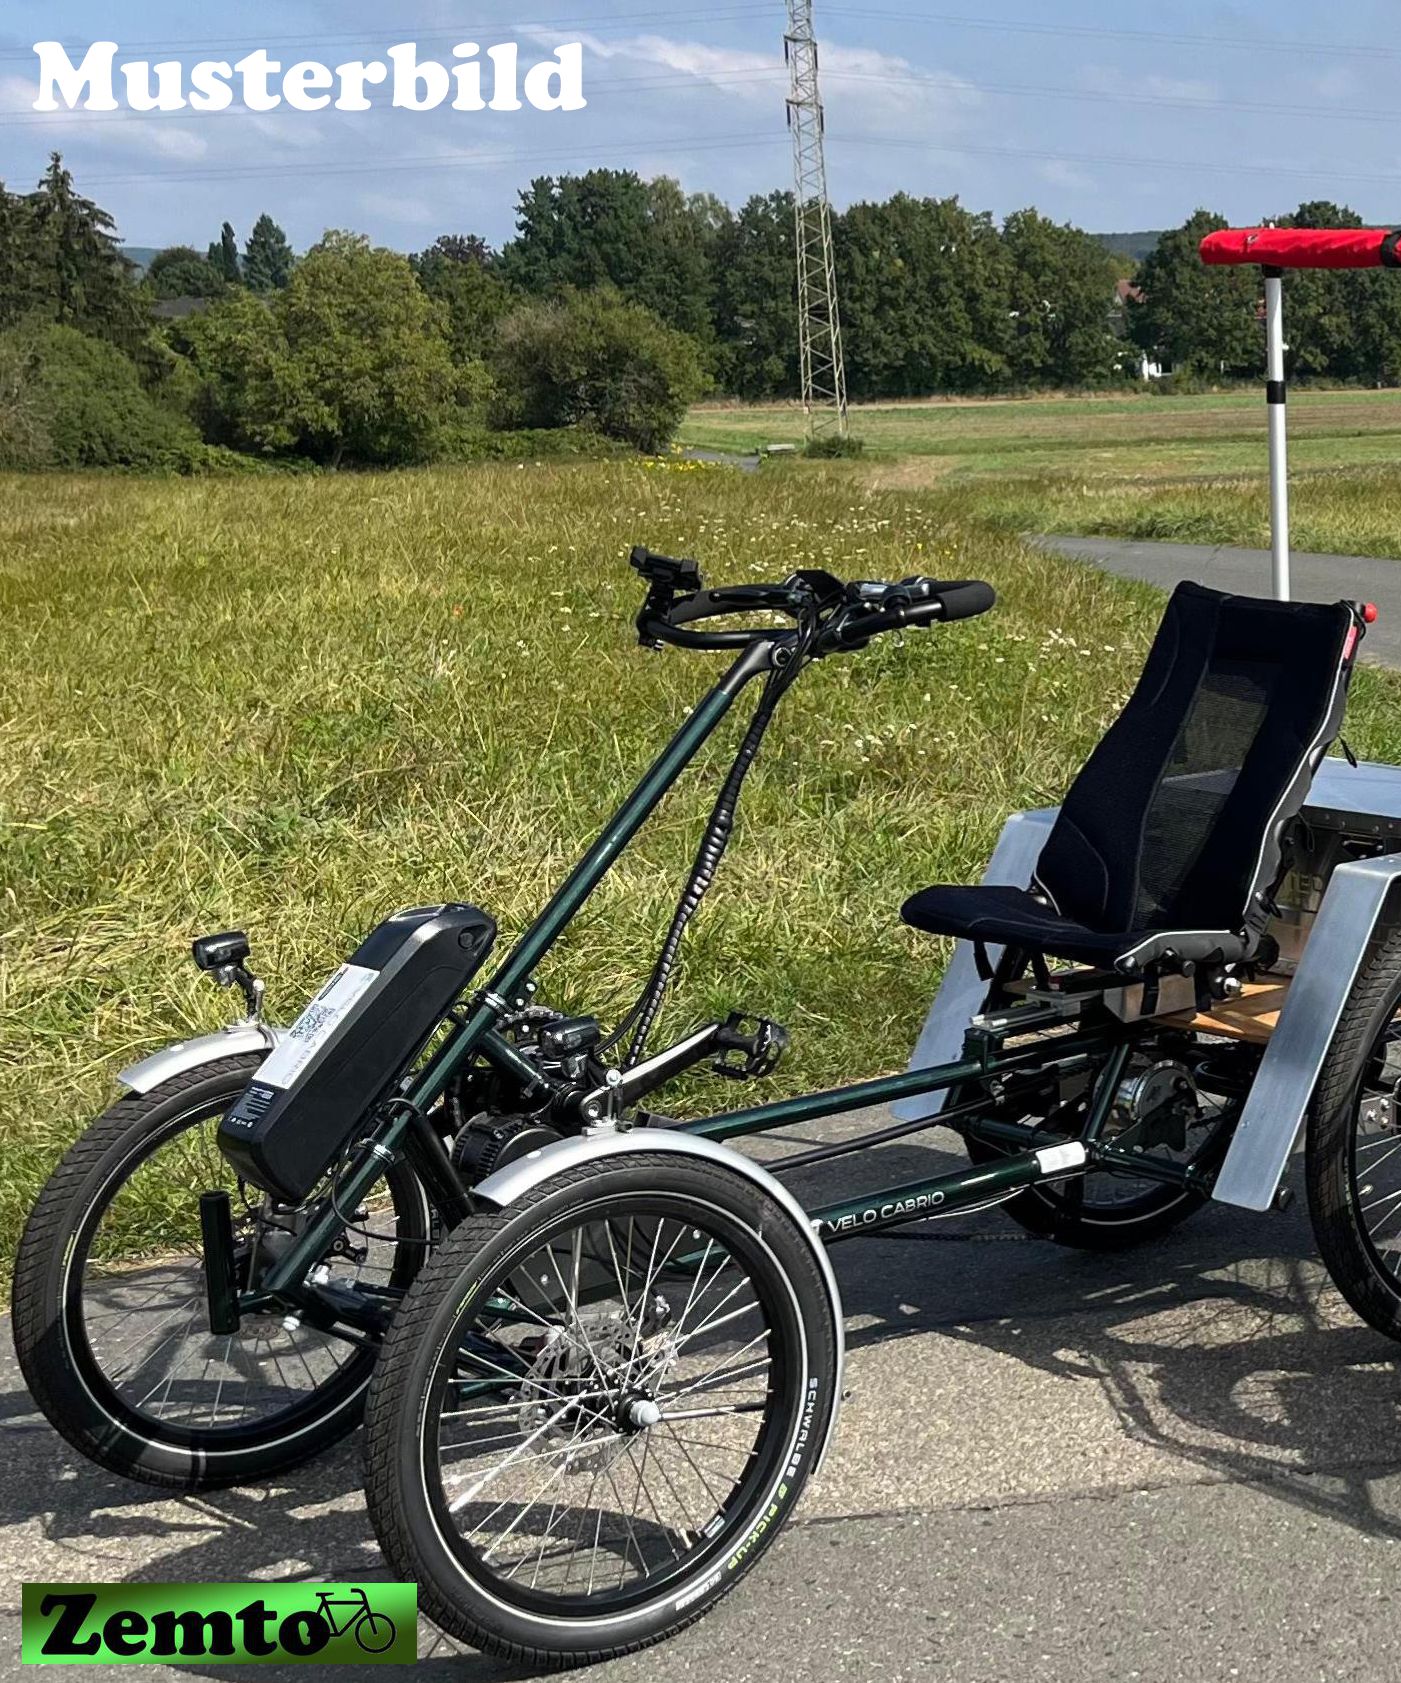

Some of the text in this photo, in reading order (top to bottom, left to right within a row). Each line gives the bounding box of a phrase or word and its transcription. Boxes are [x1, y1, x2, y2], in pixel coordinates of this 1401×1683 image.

[827, 1191, 945, 1233] VELO CABRIO
[727, 1377, 819, 1571] SCHWALBE PICK-UP
